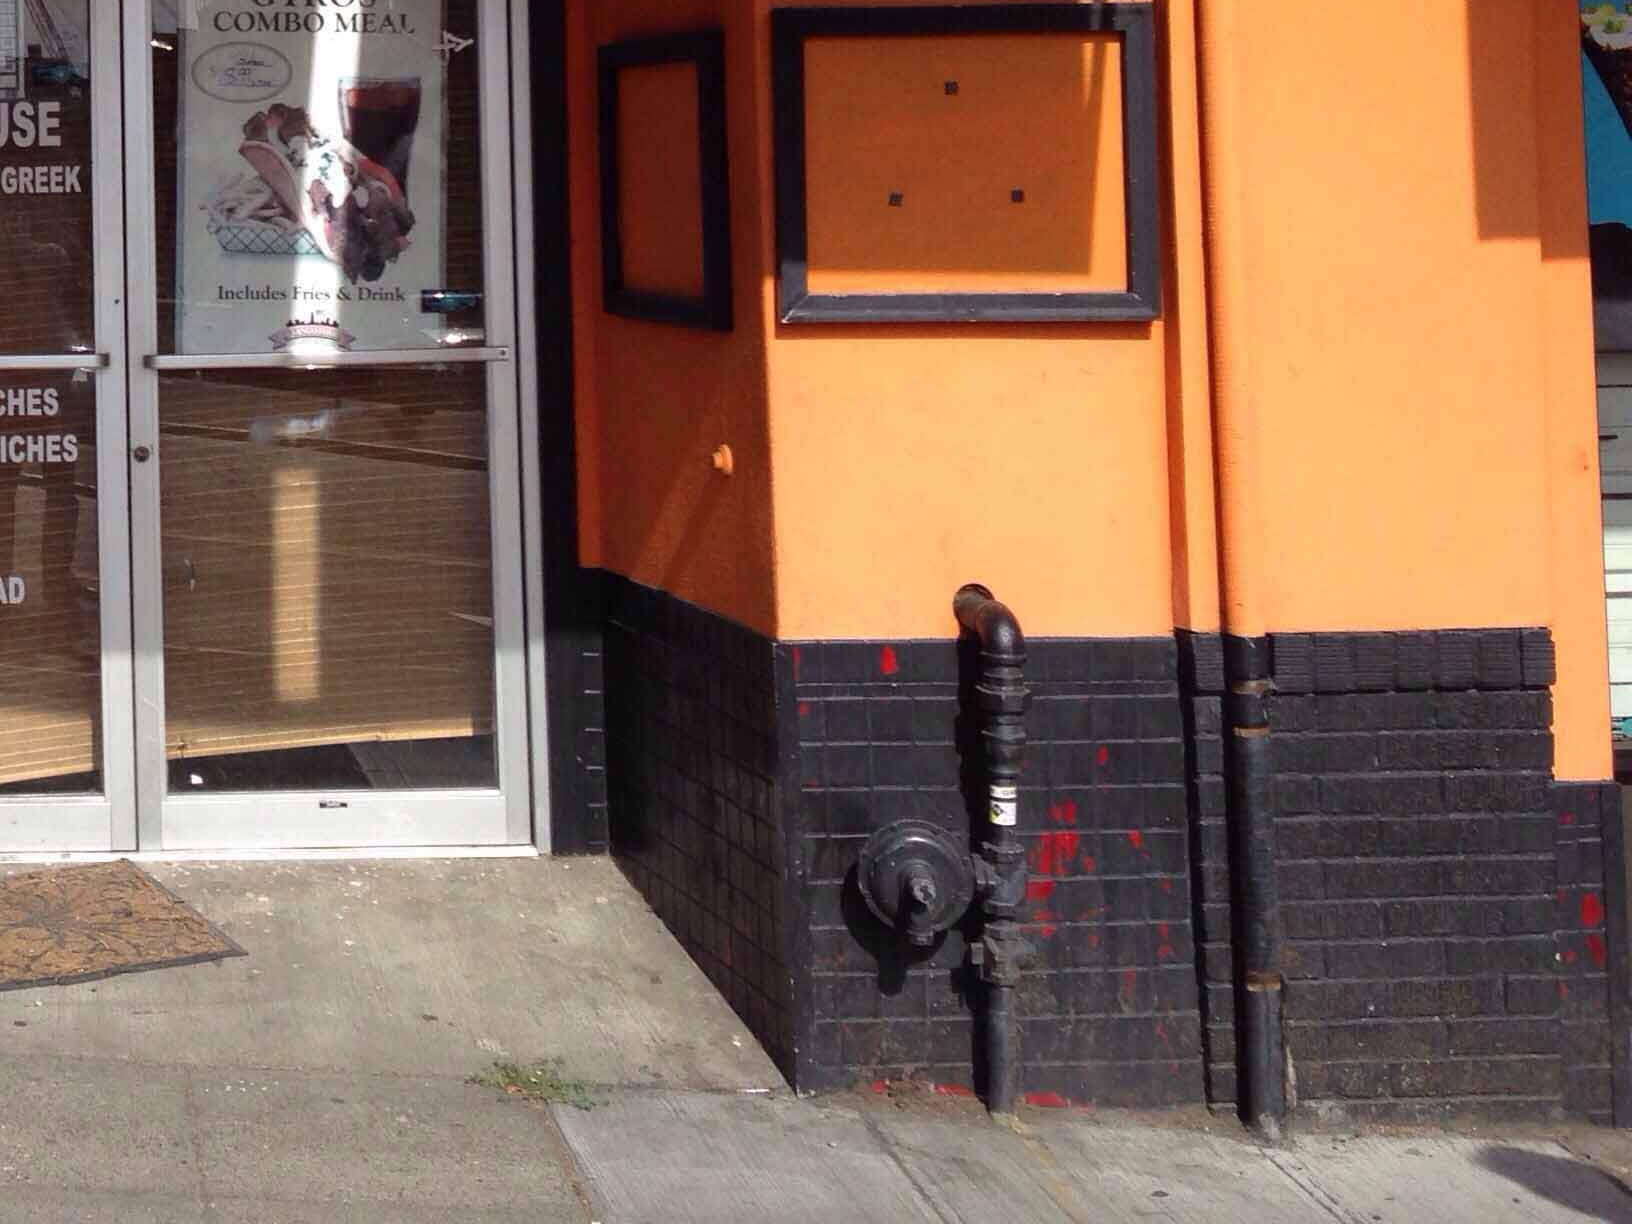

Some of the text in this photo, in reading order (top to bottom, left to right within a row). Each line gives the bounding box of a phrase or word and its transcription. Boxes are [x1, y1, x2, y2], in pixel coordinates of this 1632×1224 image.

[213, 10, 416, 34] COMBO MEAL
[1, 166, 82, 194] GREEK
[217, 284, 406, 302] Includes Fries & Drink
